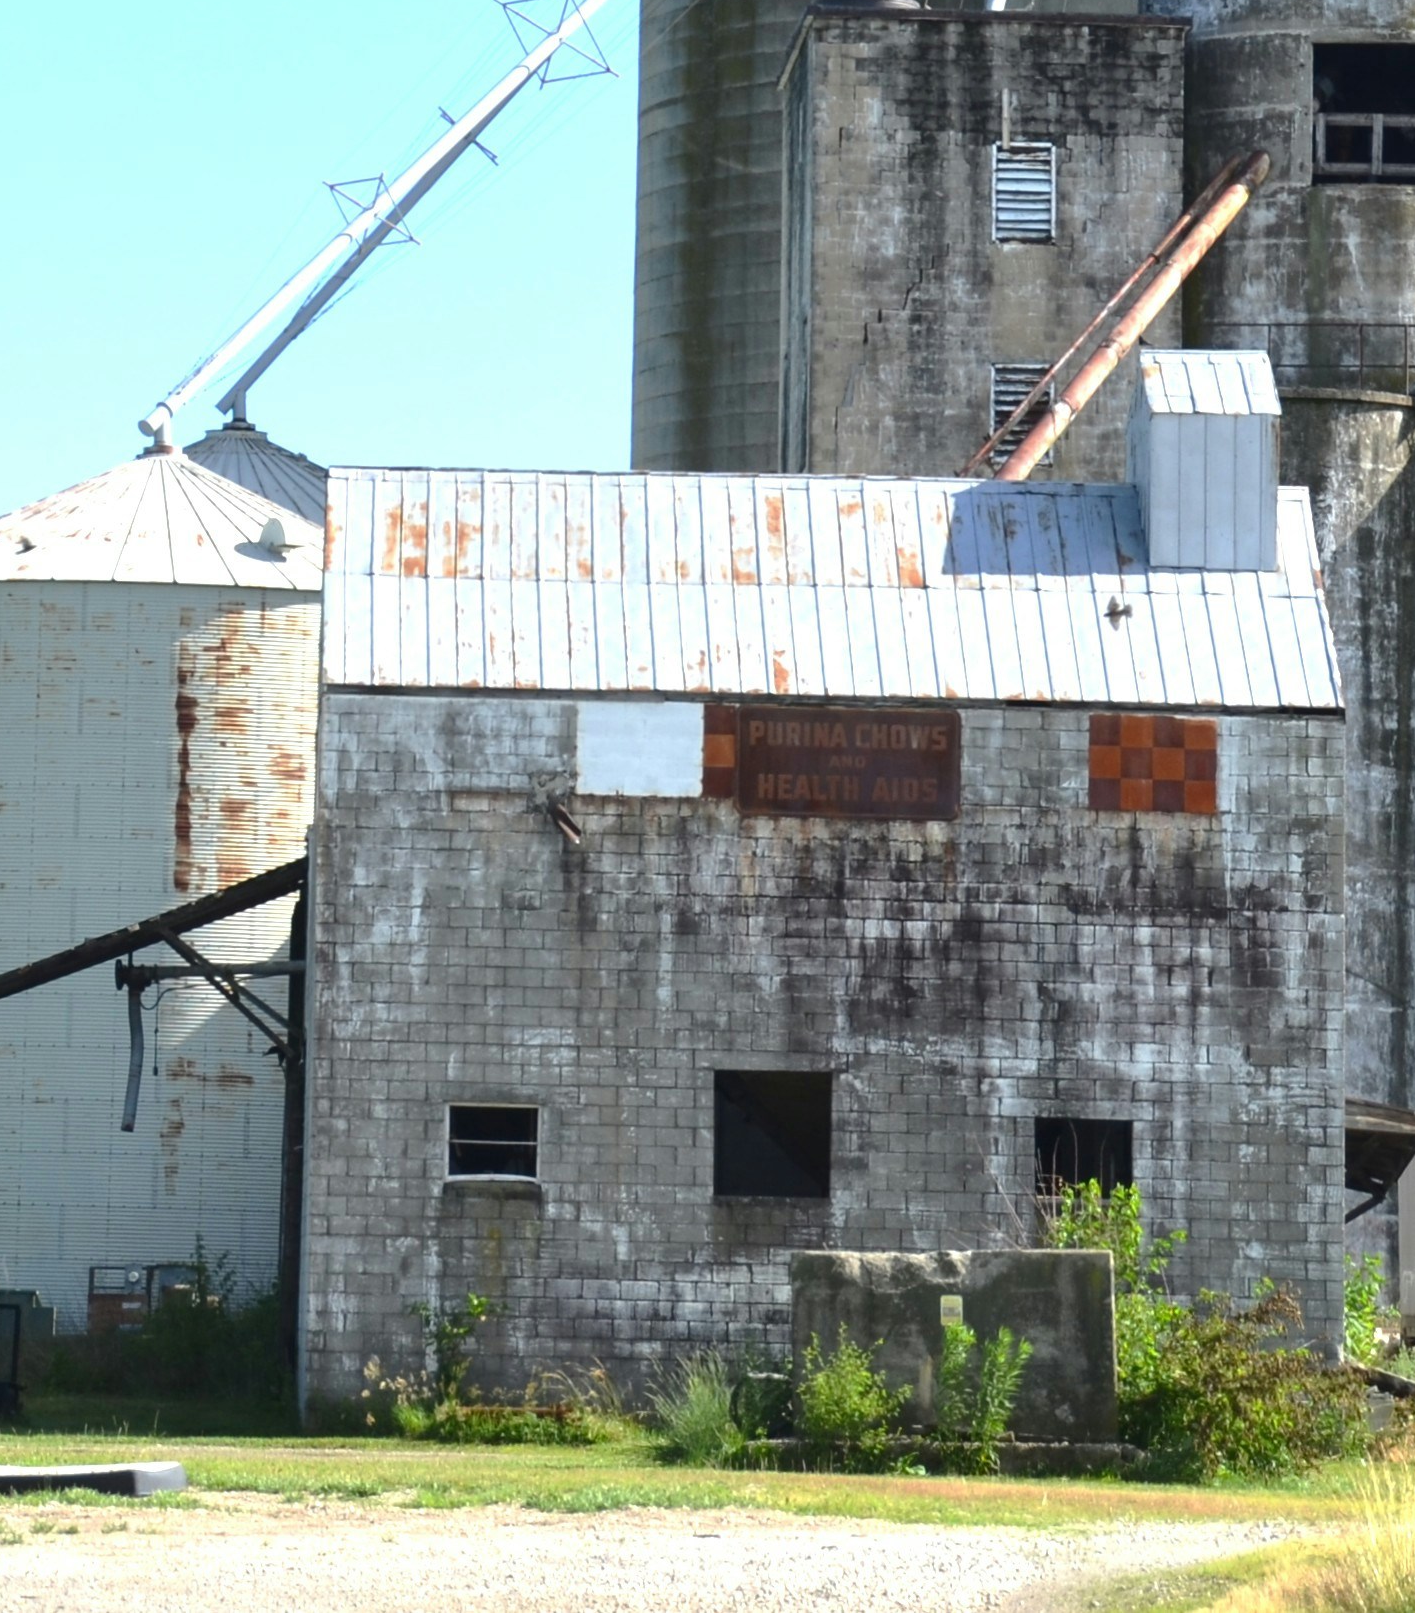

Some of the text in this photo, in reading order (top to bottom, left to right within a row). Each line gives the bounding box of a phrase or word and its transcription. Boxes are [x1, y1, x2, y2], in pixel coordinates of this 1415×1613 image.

[748, 720, 948, 751] PURINA CHOWS
[829, 755, 866, 768] AND
[757, 773, 938, 802] HEALTH AIDS
